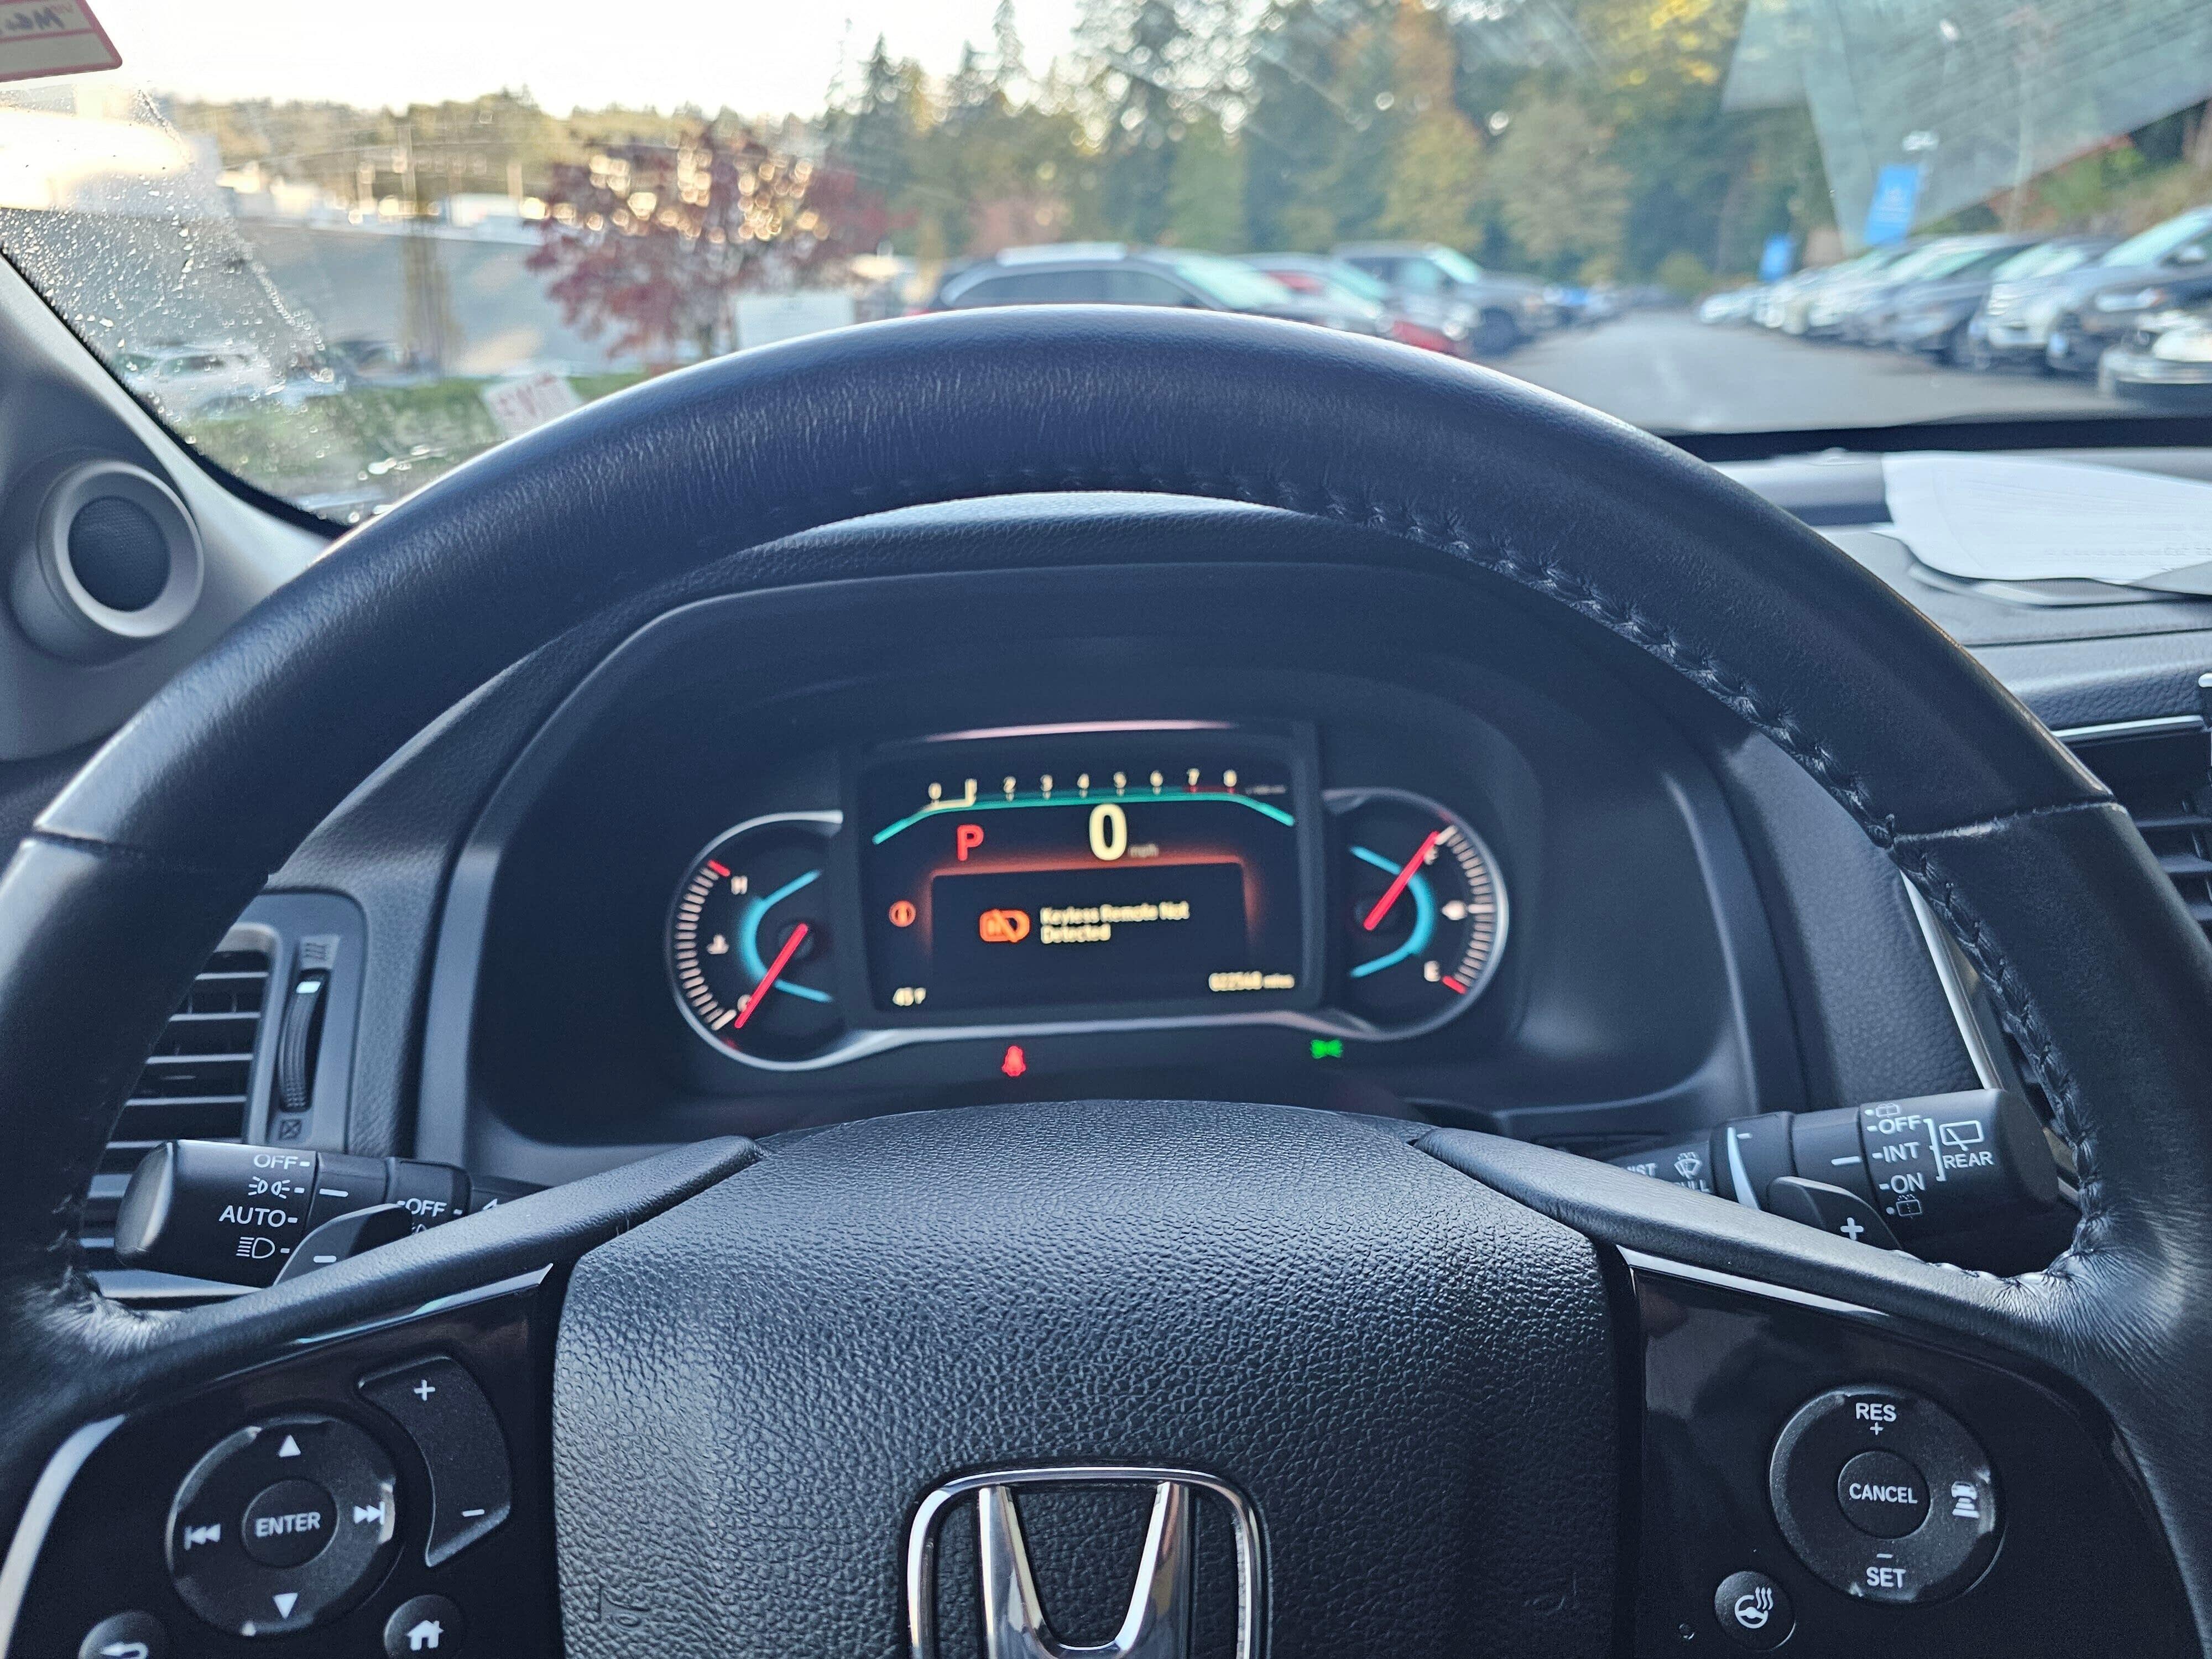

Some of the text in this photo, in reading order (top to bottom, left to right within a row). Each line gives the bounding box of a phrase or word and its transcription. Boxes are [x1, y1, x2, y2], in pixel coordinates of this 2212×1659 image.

[928, 782, 942, 800] 0
[1003, 776, 1016, 793] 2
[1040, 774, 1053, 792] 3
[1187, 768, 1199, 785] 7
[957, 825, 984, 861] P
[1089, 804, 1127, 860] 0
[1040, 900, 1190, 926] Keyless Remote Not
[1041, 923, 1111, 945] Detected
[1878, 1115, 1922, 1134] OFF
[253, 1154, 299, 1169] OFF
[1882, 1141, 1921, 1163] INT
[1942, 1151, 1995, 1170] REAR
[1891, 1172, 1926, 1194] ON
[219, 1205, 286, 1228] AUTO
[405, 1198, 447, 1217] OFF
[1855, 1402, 1897, 1423] RES
[1849, 1483, 1917, 1505] CANCEL
[255, 1511, 321, 1538] ENTER
[1866, 1567, 1906, 1588] SET
